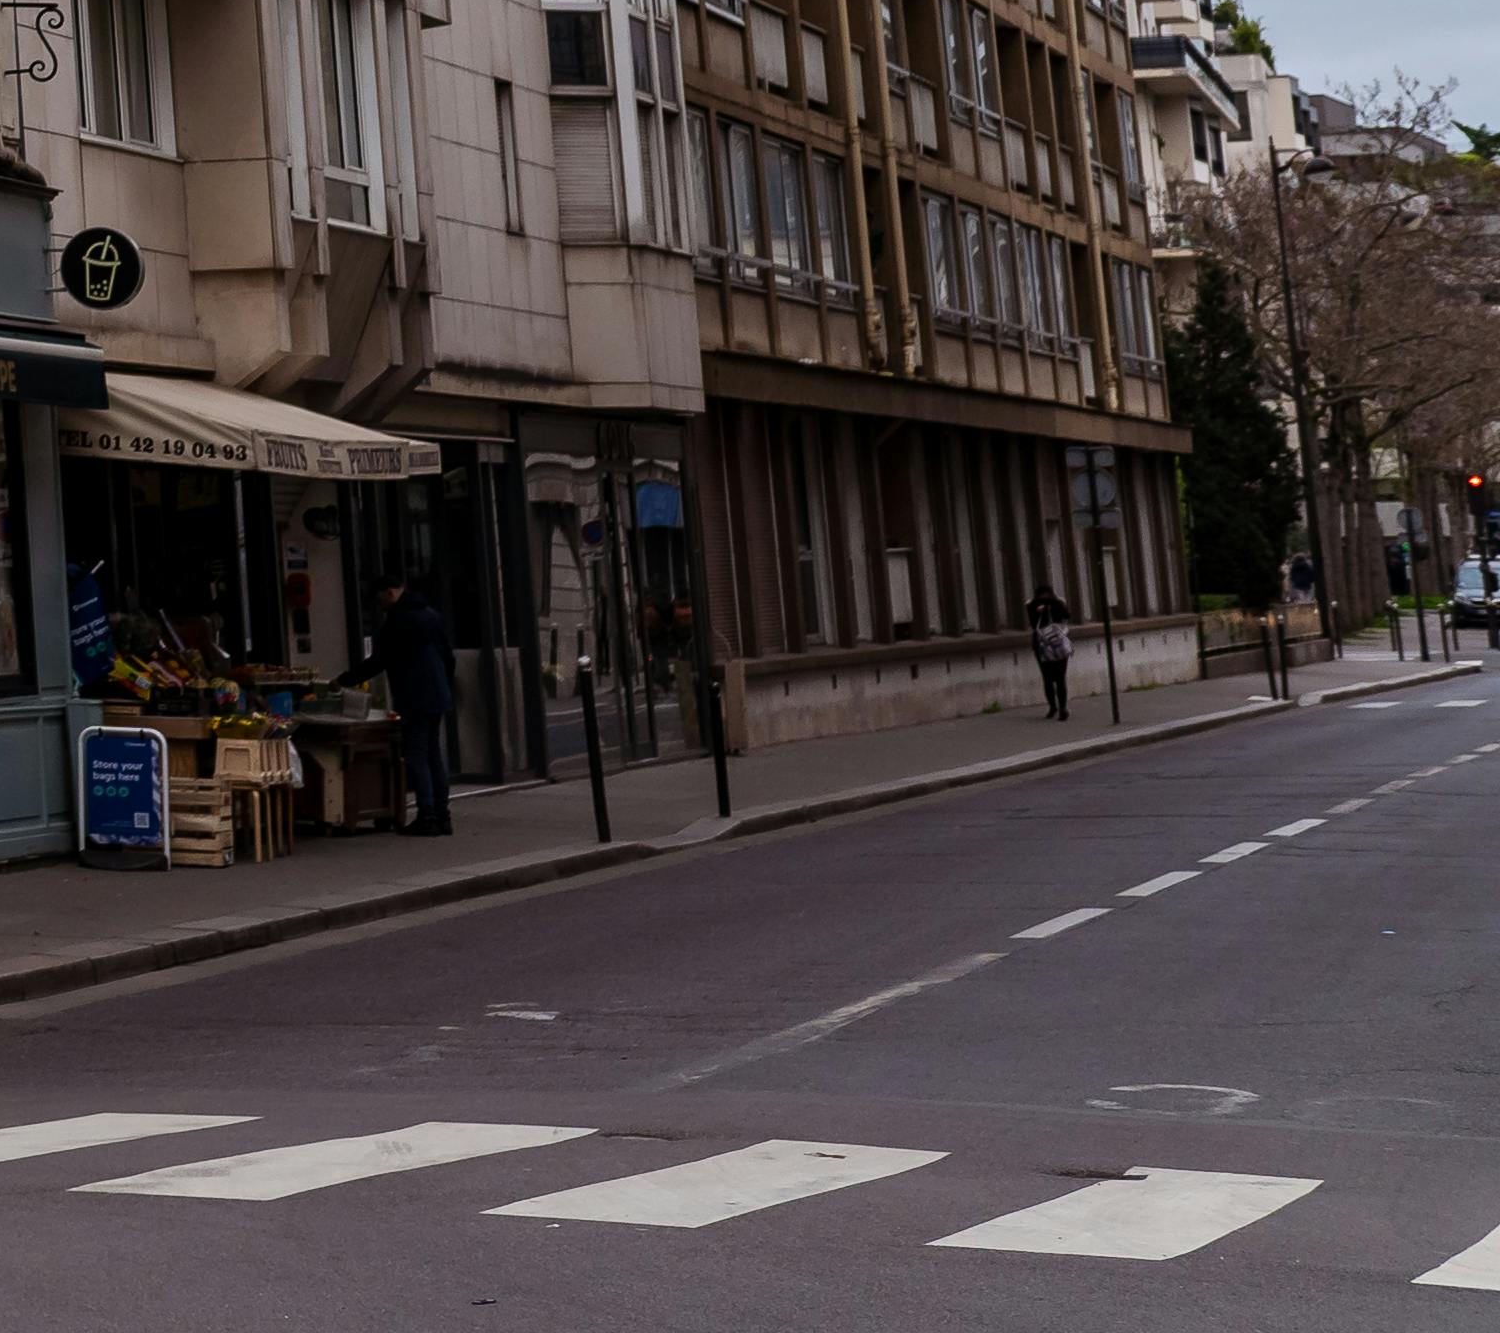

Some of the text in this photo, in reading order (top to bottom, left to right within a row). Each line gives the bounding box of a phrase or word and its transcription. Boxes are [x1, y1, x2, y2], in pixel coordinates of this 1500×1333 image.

[99, 434, 121, 451] 01
[130, 437, 155, 454] 42
[162, 440, 186, 456] 19
[192, 442, 217, 459] 04
[223, 445, 248, 461] 93
[265, 439, 308, 471] FRUITS
[346, 447, 403, 479] PRIMEURS
[92, 759, 145, 772] Store your
[92, 772, 141, 783] bags here
